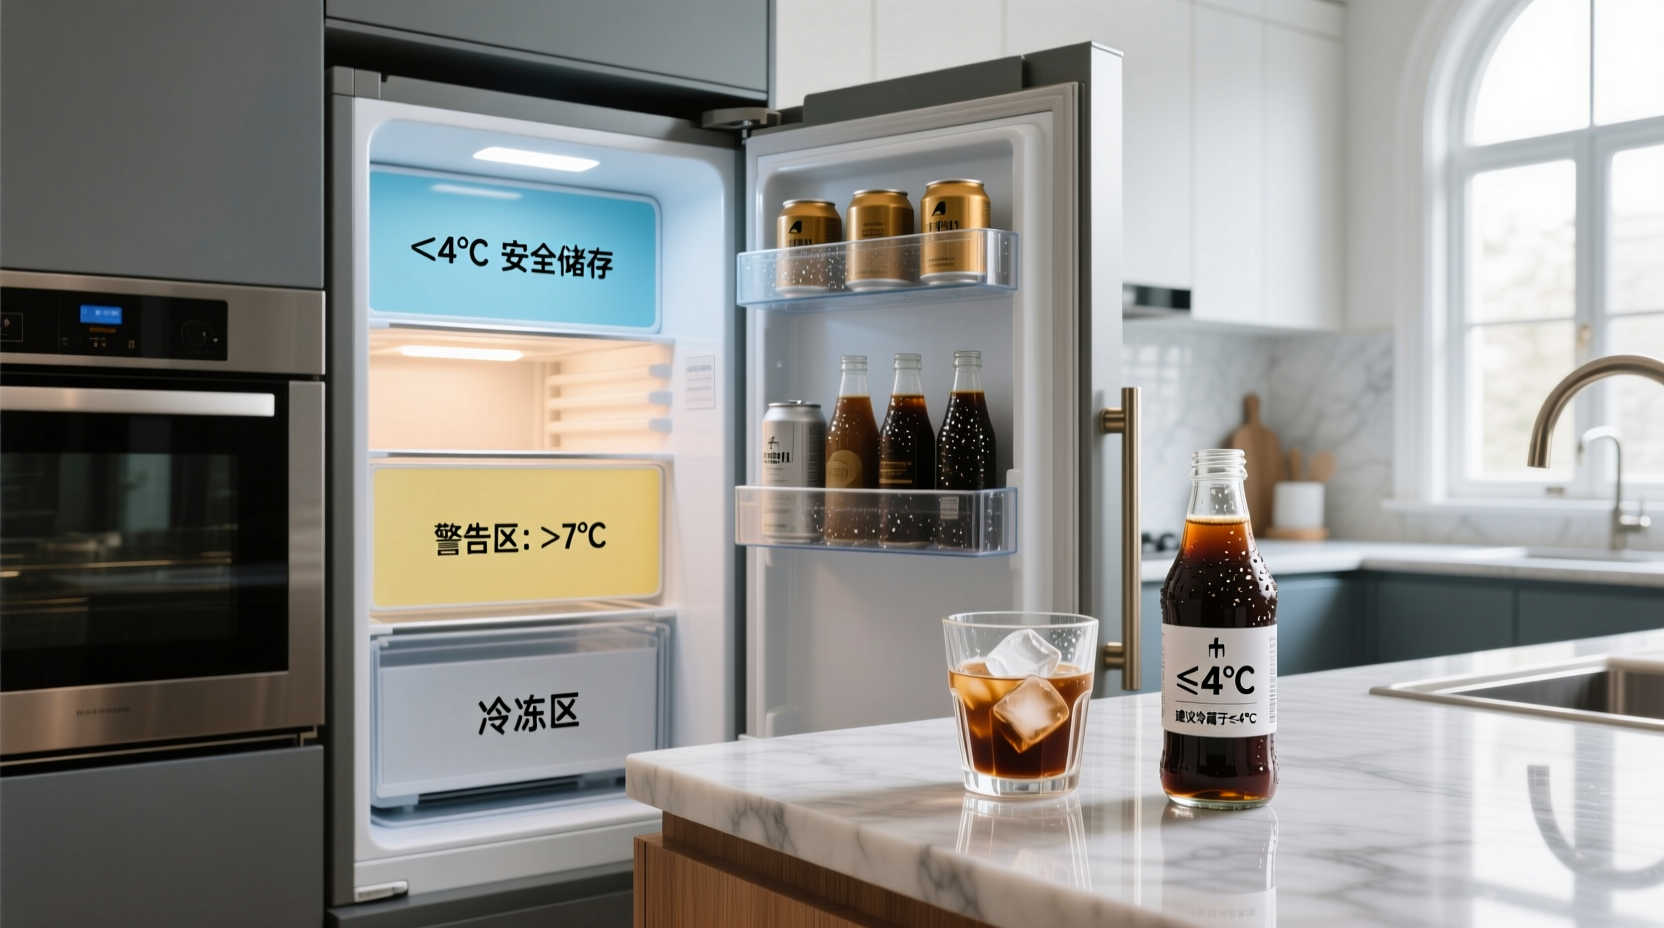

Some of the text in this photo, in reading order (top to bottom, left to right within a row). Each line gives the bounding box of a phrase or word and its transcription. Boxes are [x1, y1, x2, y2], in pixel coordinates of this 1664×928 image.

[501, 239, 614, 279] 安全储存
[478, 692, 580, 736] 冷冻区
